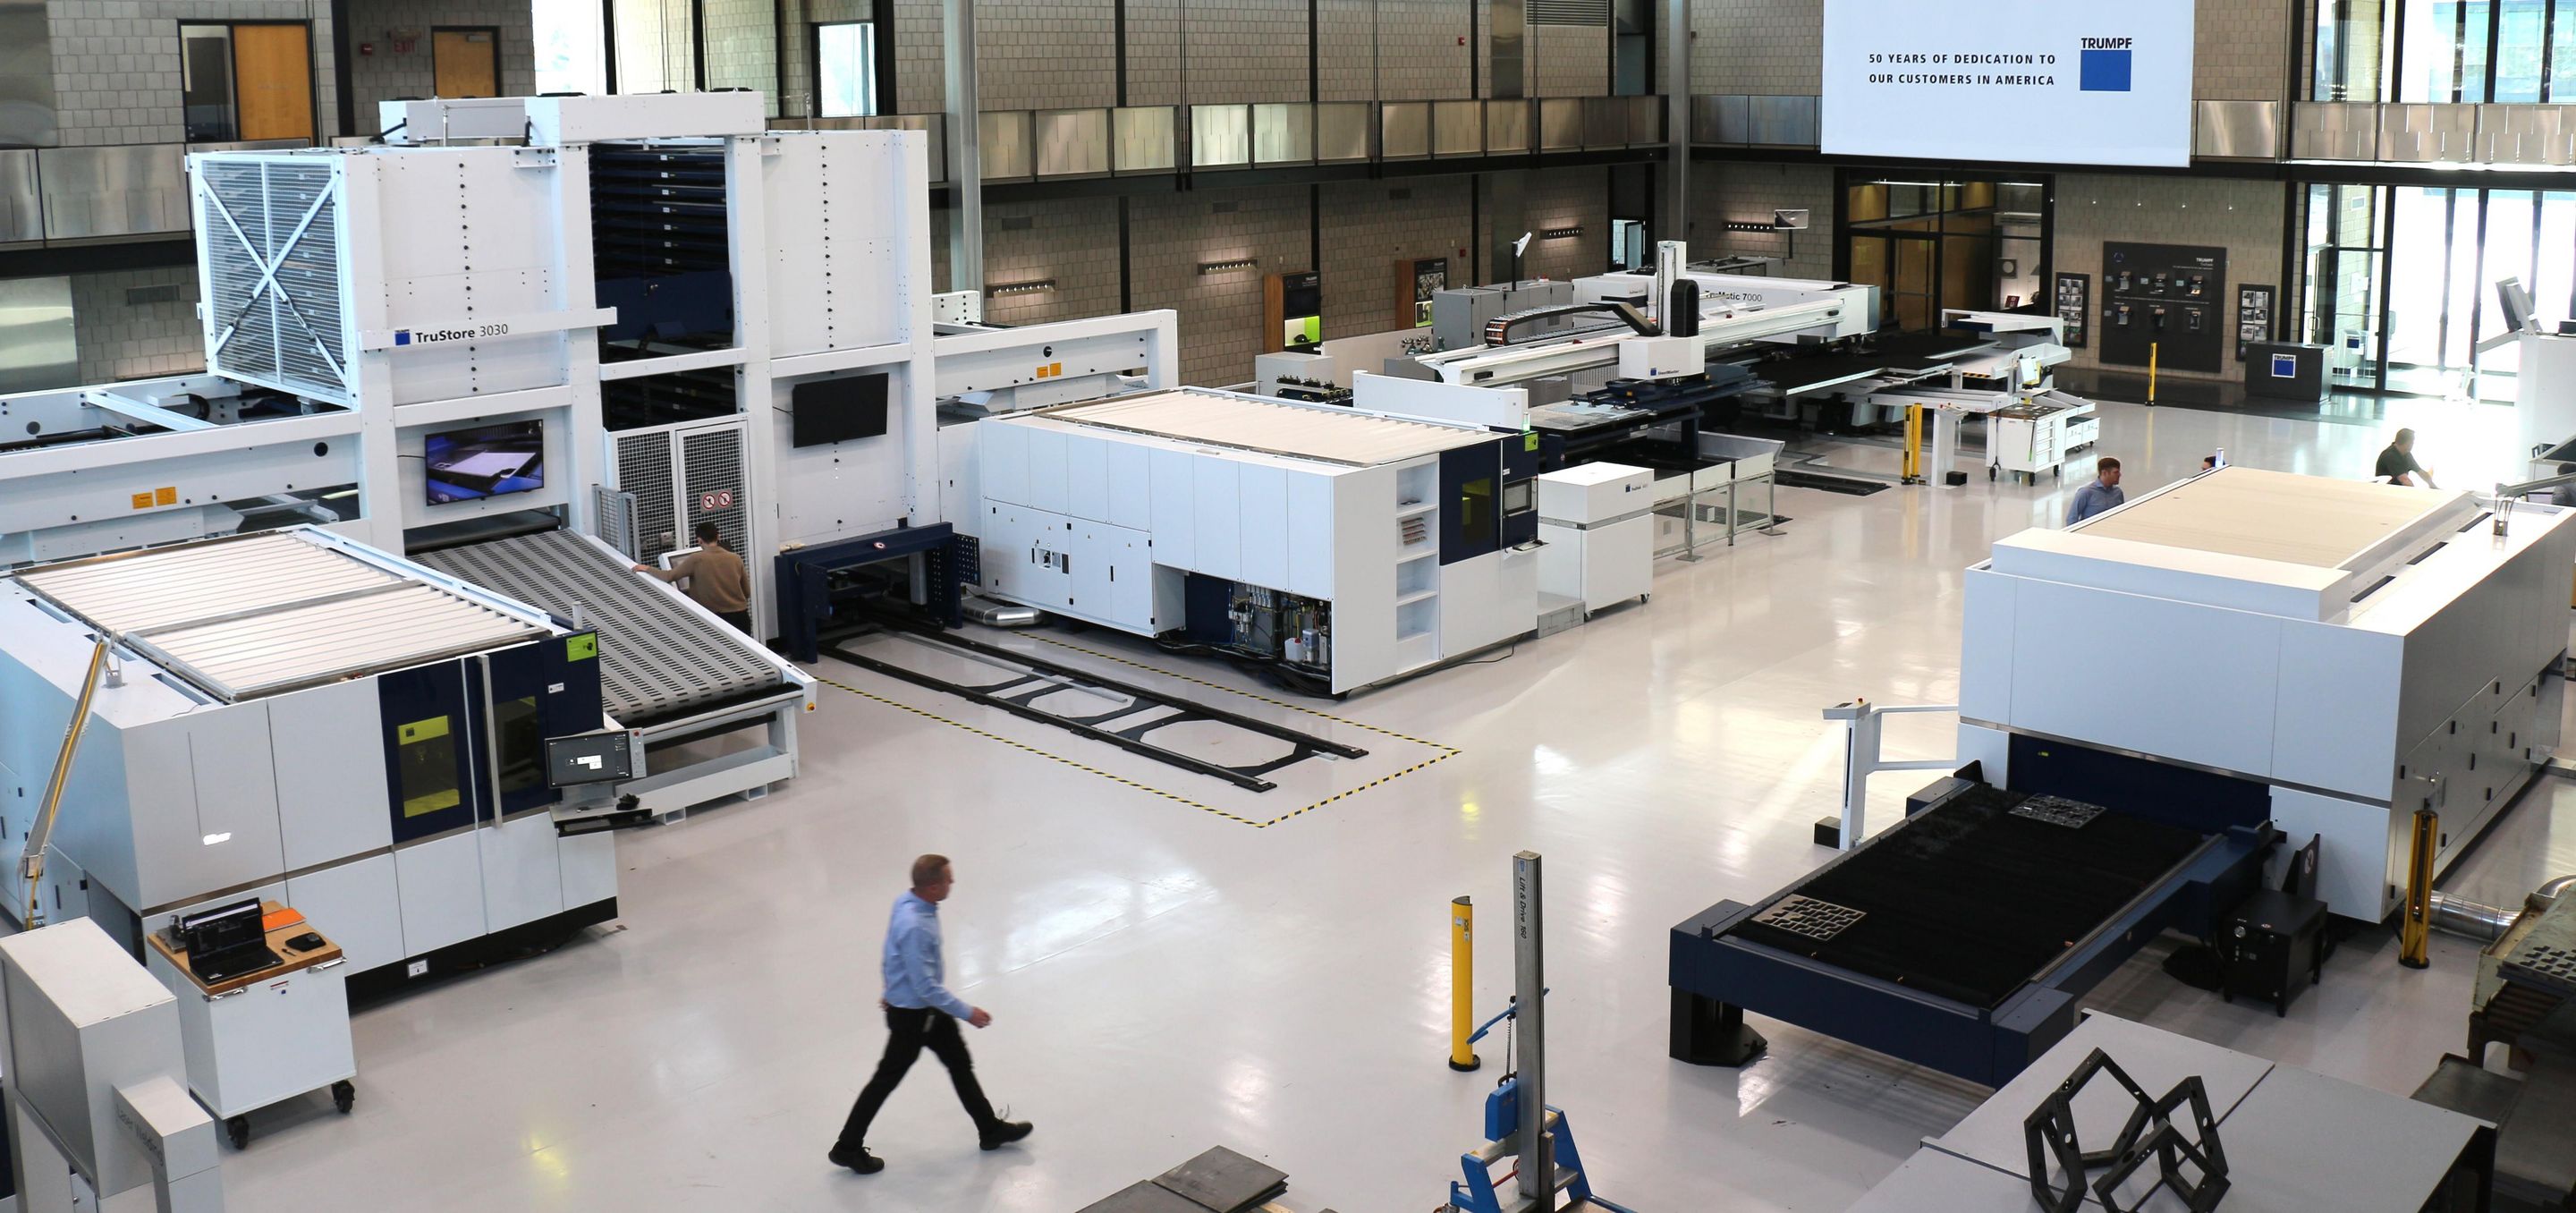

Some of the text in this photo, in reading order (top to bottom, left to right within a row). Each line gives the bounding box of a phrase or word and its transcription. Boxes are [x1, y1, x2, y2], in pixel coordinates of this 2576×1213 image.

[2080, 38, 2132, 49] TRUMPF
[1868, 54, 2055, 64] 50 YEARS OF DEDICATION TO
[1868, 73, 2055, 86] OUR CUSTOMERS IN AMERICA
[1742, 293, 1762, 302] 7000
[415, 324, 508, 344] TruStore 3030
